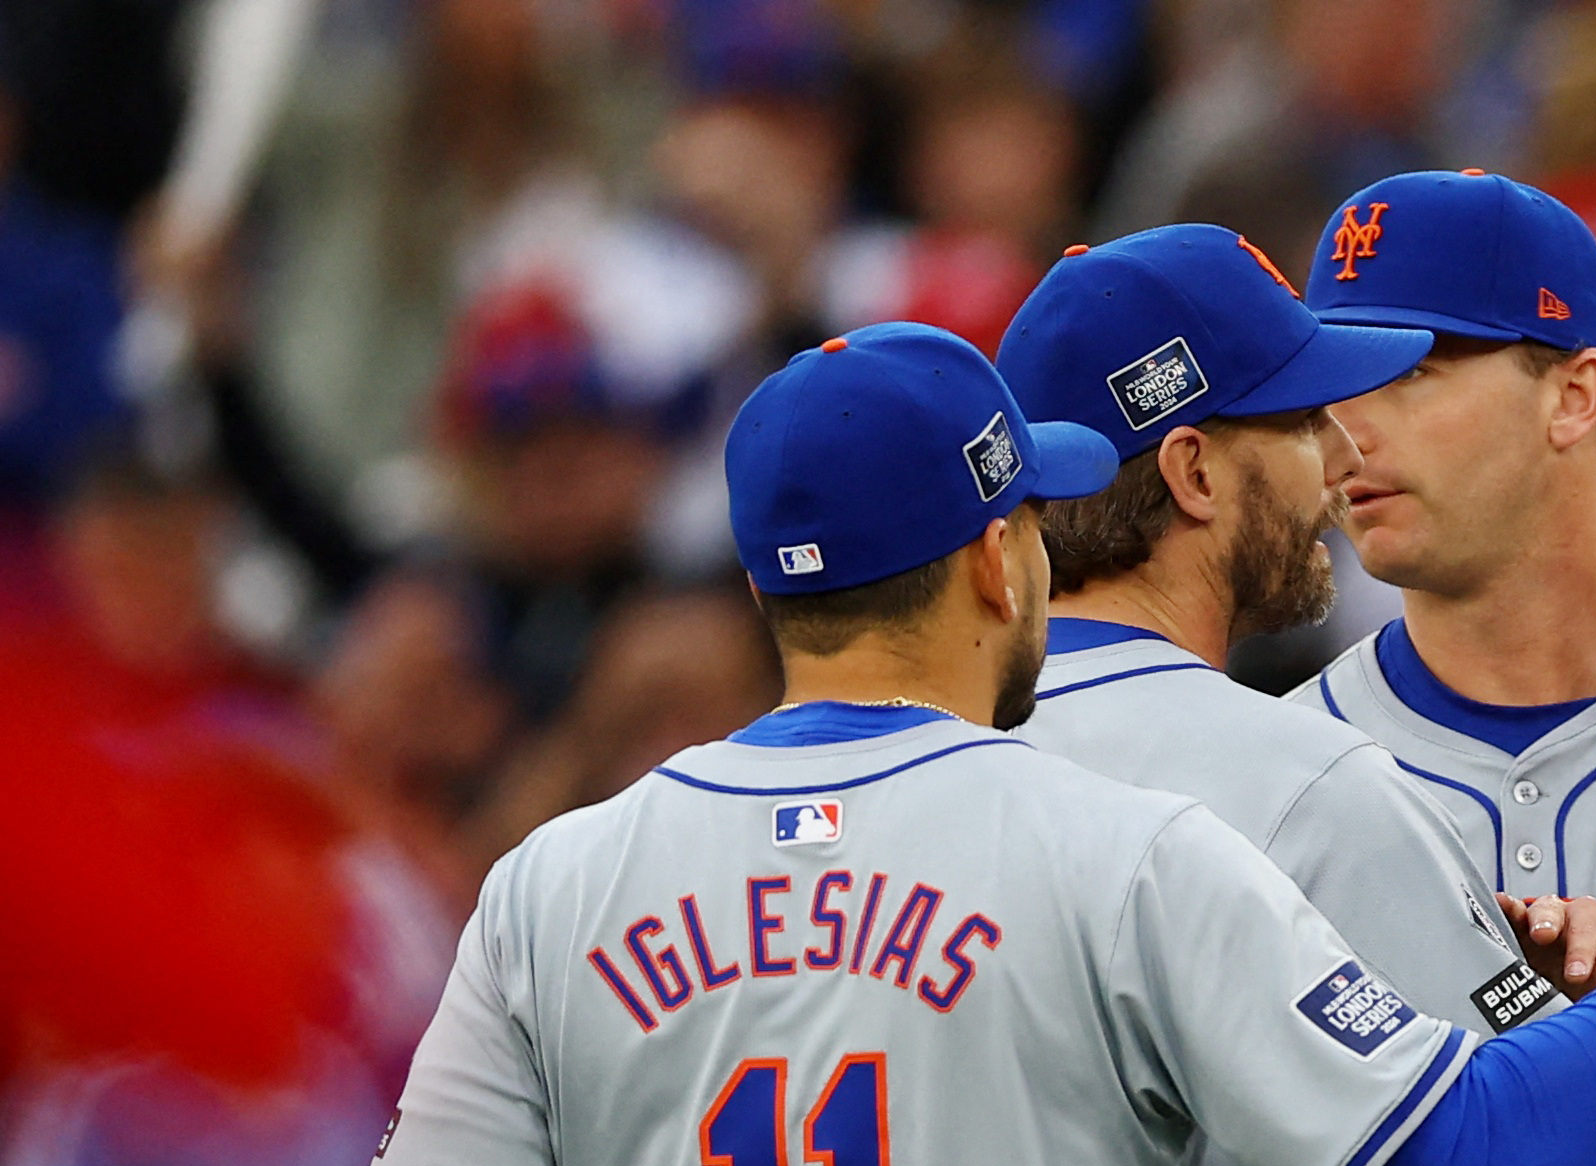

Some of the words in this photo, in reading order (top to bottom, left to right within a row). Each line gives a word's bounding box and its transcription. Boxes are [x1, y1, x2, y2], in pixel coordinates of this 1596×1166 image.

[1126, 361, 1188, 403] LONDON
[1138, 377, 1188, 411] SERIES
[587, 870, 1002, 1033] IGLESIAS
[1482, 965, 1535, 1009] BUILD
[1351, 994, 1403, 1037] SERIES
